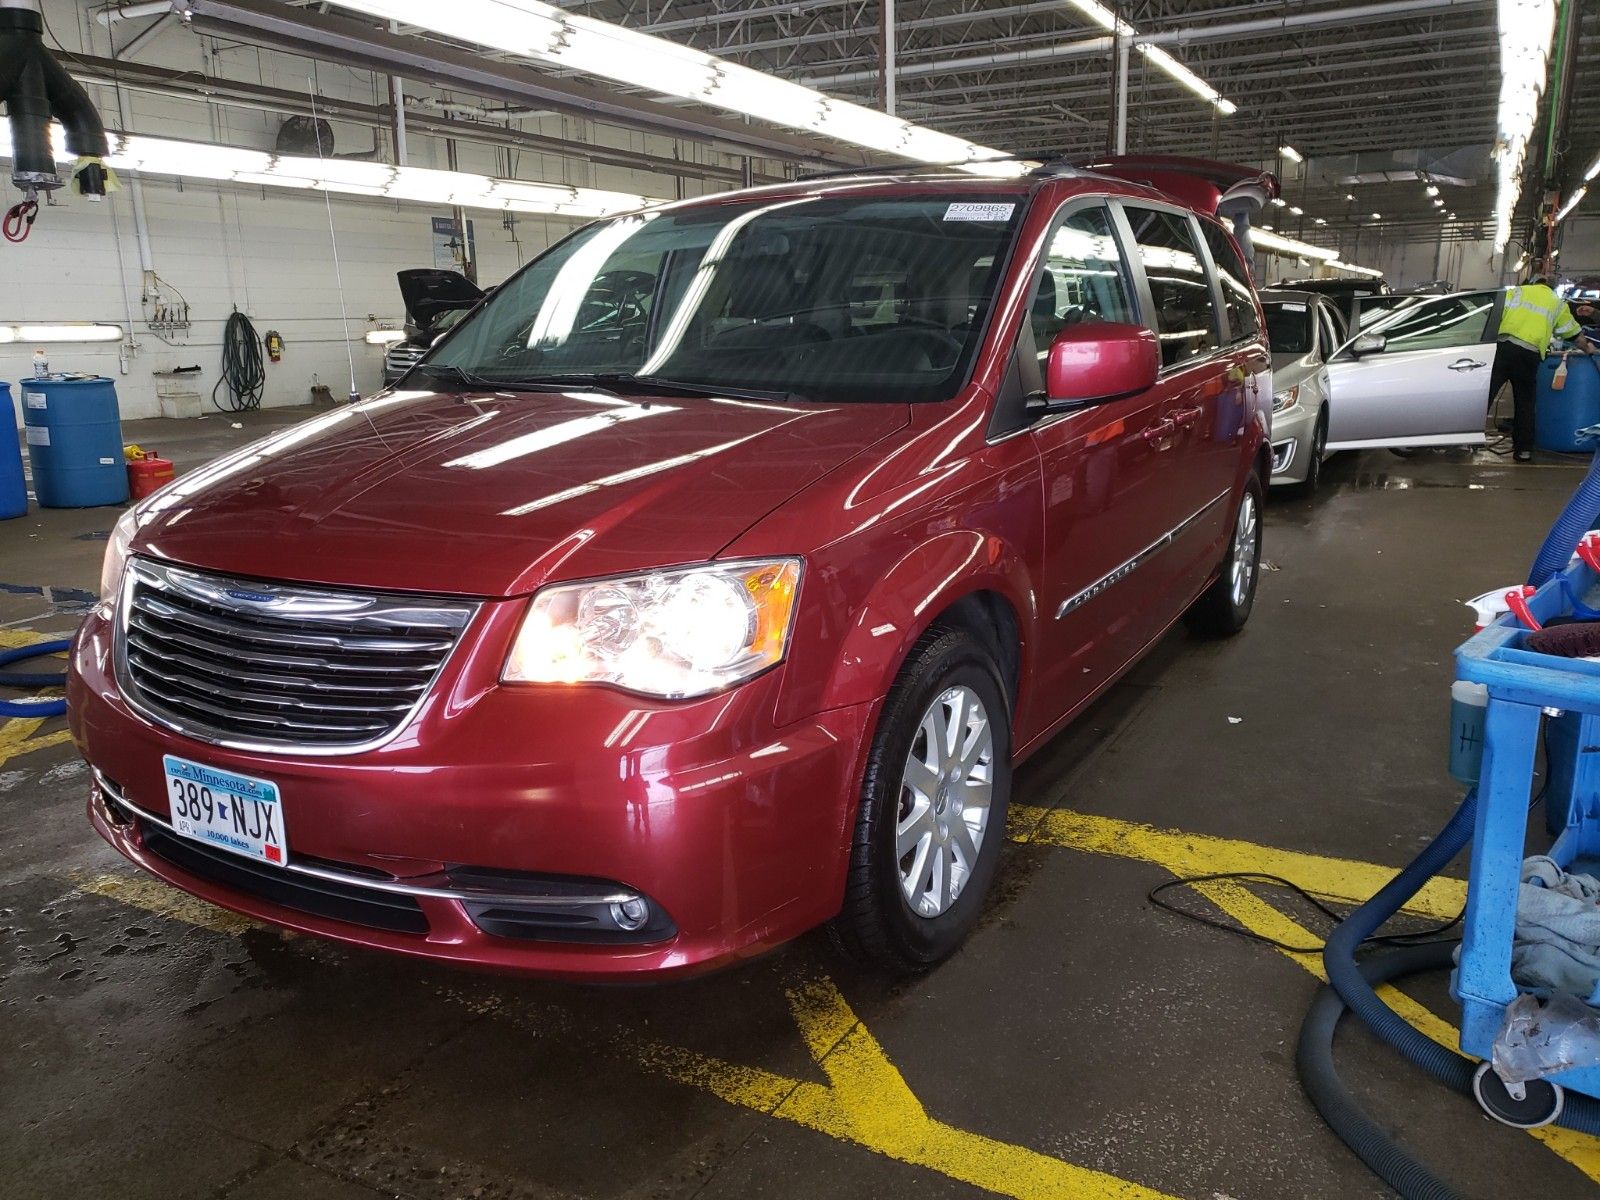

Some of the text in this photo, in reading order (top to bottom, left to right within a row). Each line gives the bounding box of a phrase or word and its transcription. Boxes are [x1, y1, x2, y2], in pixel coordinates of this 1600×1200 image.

[949, 204, 1008, 212] 2709865
[173, 778, 278, 845] 389 NJX
